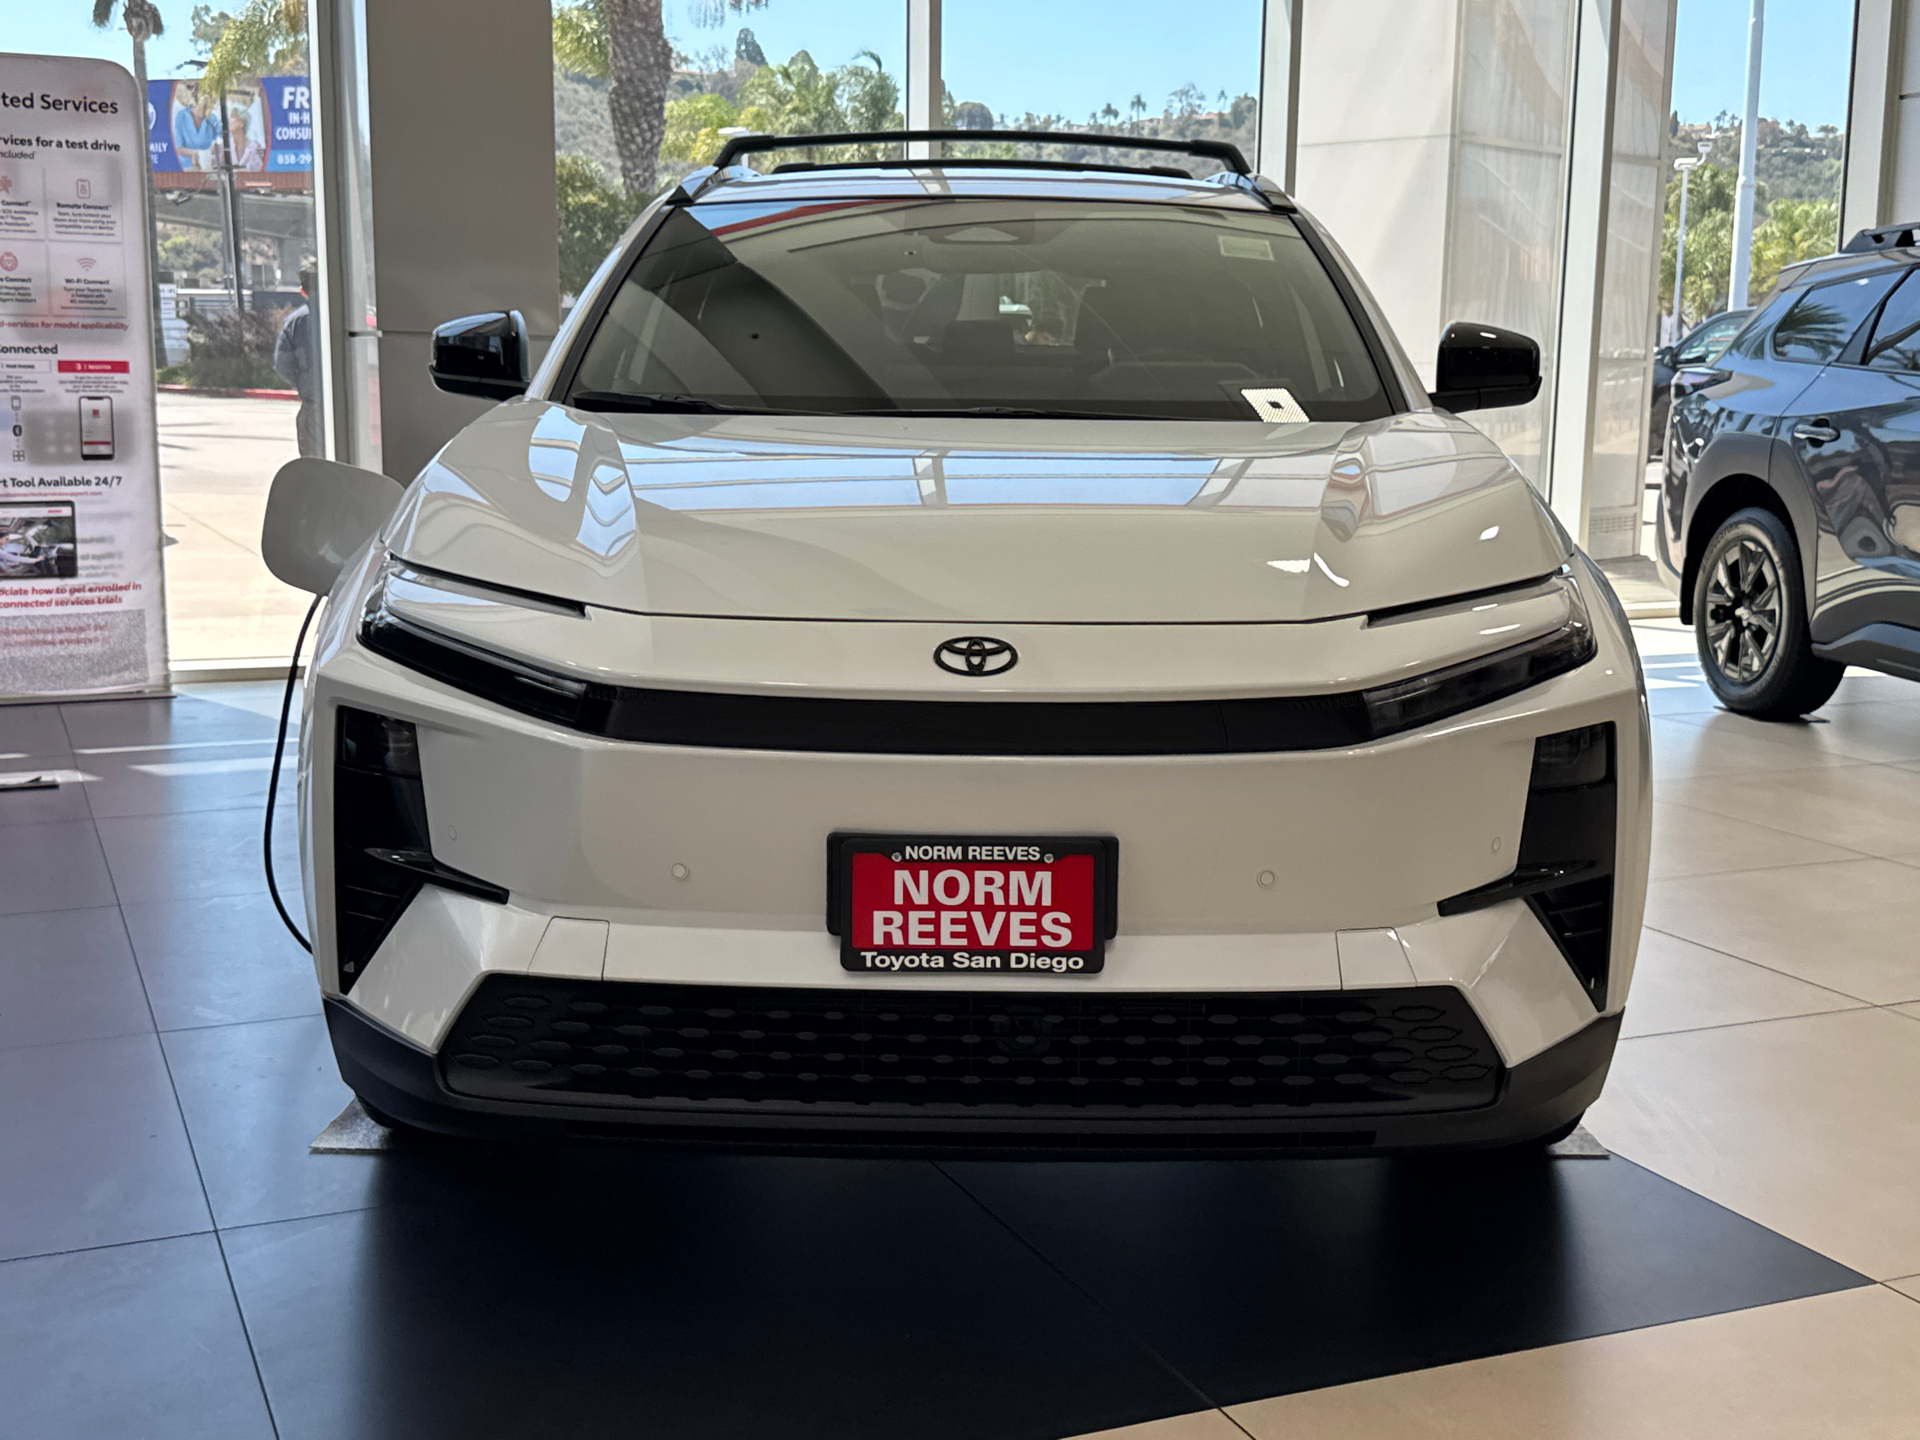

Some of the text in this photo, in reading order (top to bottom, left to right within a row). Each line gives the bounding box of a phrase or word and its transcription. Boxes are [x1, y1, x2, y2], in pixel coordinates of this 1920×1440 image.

[2, 92, 118, 114] ted Services
[36, 136, 54, 147] for
[56, 140, 63, 148] a
[65, 138, 88, 150] test
[90, 139, 121, 152] drive
[41, 320, 53, 330] for
[54, 321, 80, 330] model
[80, 322, 129, 332] applicability
[10, 477, 35, 488] Tool
[38, 476, 92, 488] Available
[94, 476, 122, 488] 24/7
[31, 586, 54, 595] how
[56, 586, 66, 594] to
[69, 586, 86, 596] get
[88, 582, 130, 592] enrolled
[132, 582, 142, 590] in
[54, 598, 96, 607] services
[98, 594, 122, 605] trials
[905, 846, 1041, 862] NORM REEVES
[893, 868, 1052, 907] NORM
[872, 910, 1073, 948] REEVES
[860, 951, 1084, 973] Toyota San Diego
